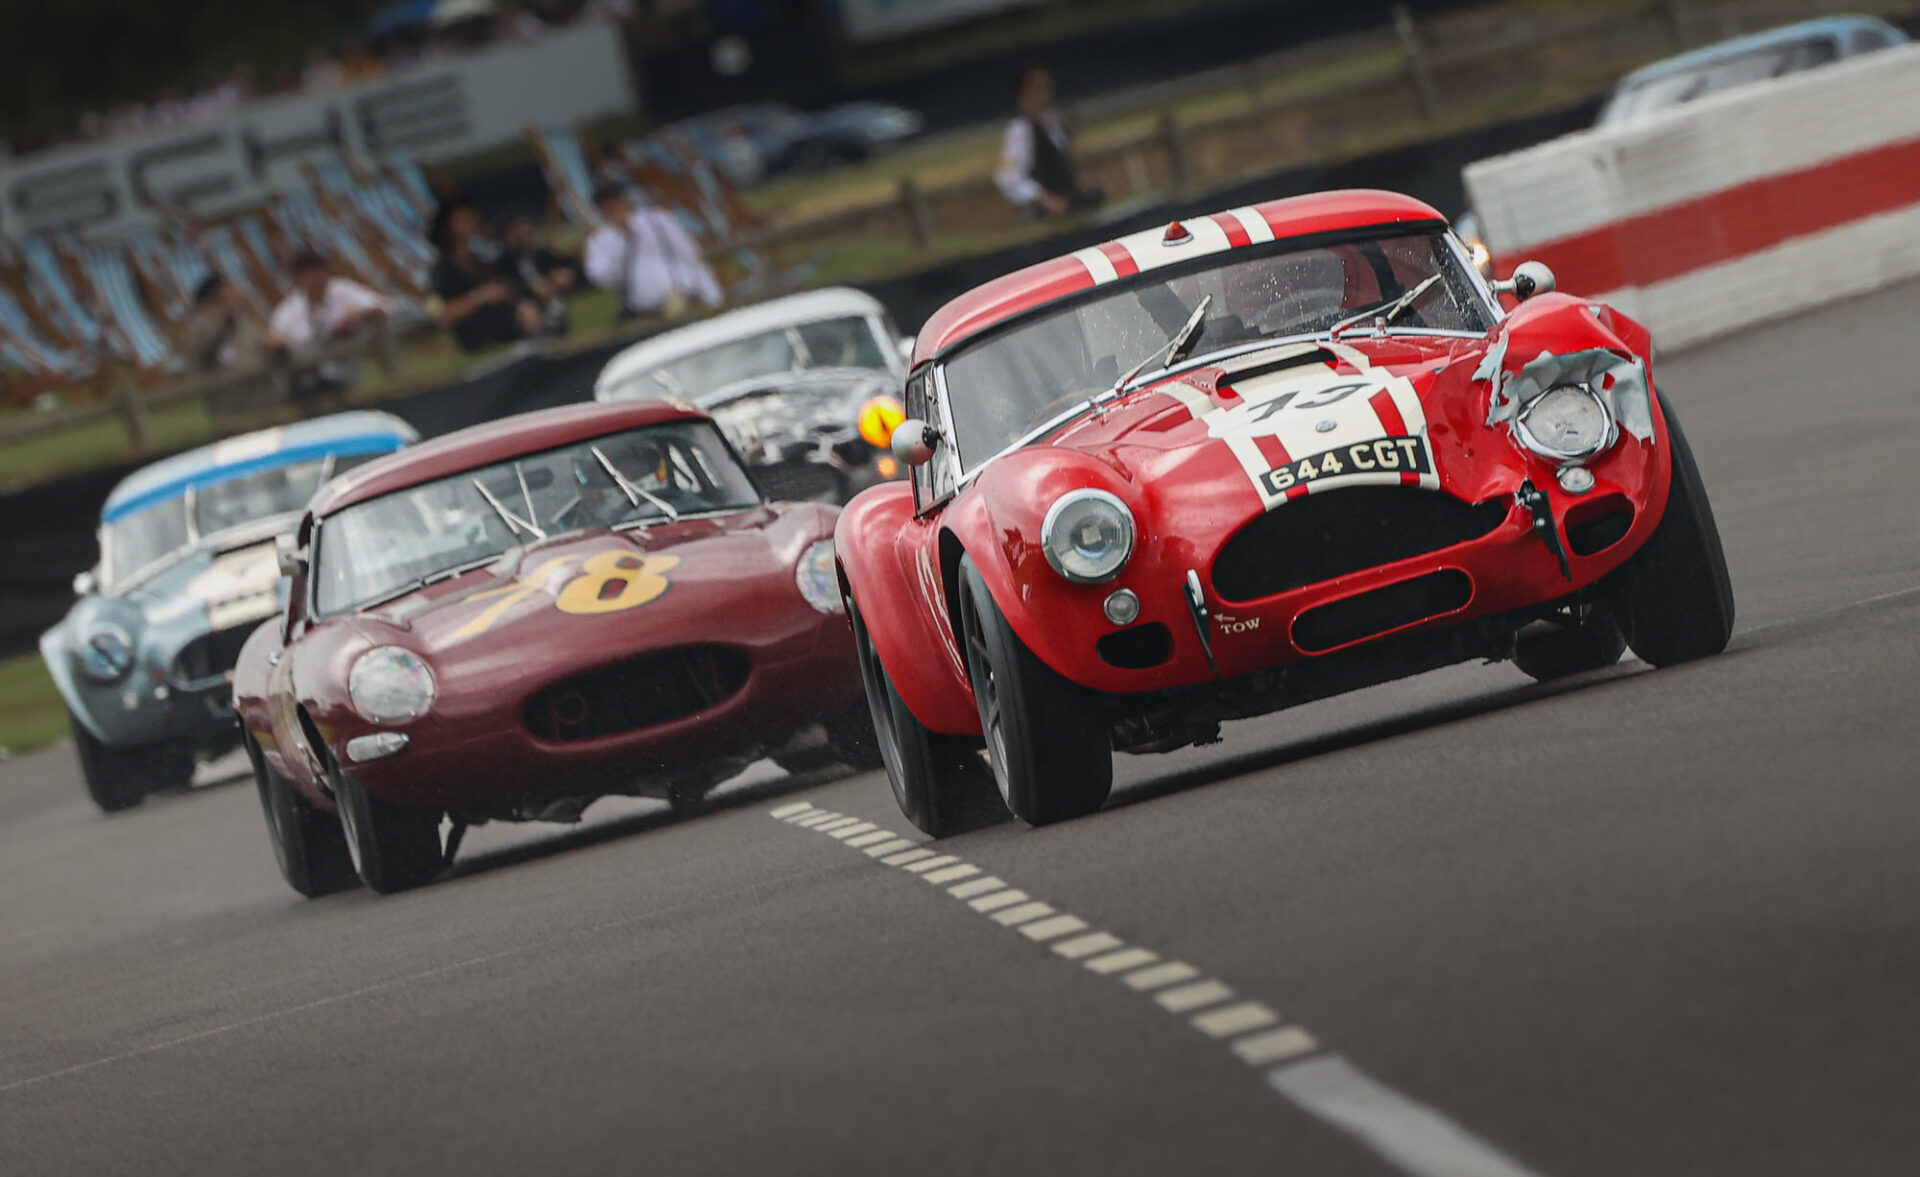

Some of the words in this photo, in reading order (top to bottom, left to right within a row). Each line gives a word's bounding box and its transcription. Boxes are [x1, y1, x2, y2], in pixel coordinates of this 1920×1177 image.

[1269, 451, 1343, 490] 644
[1348, 438, 1418, 470] CGT
[1220, 616, 1260, 635] TOW
